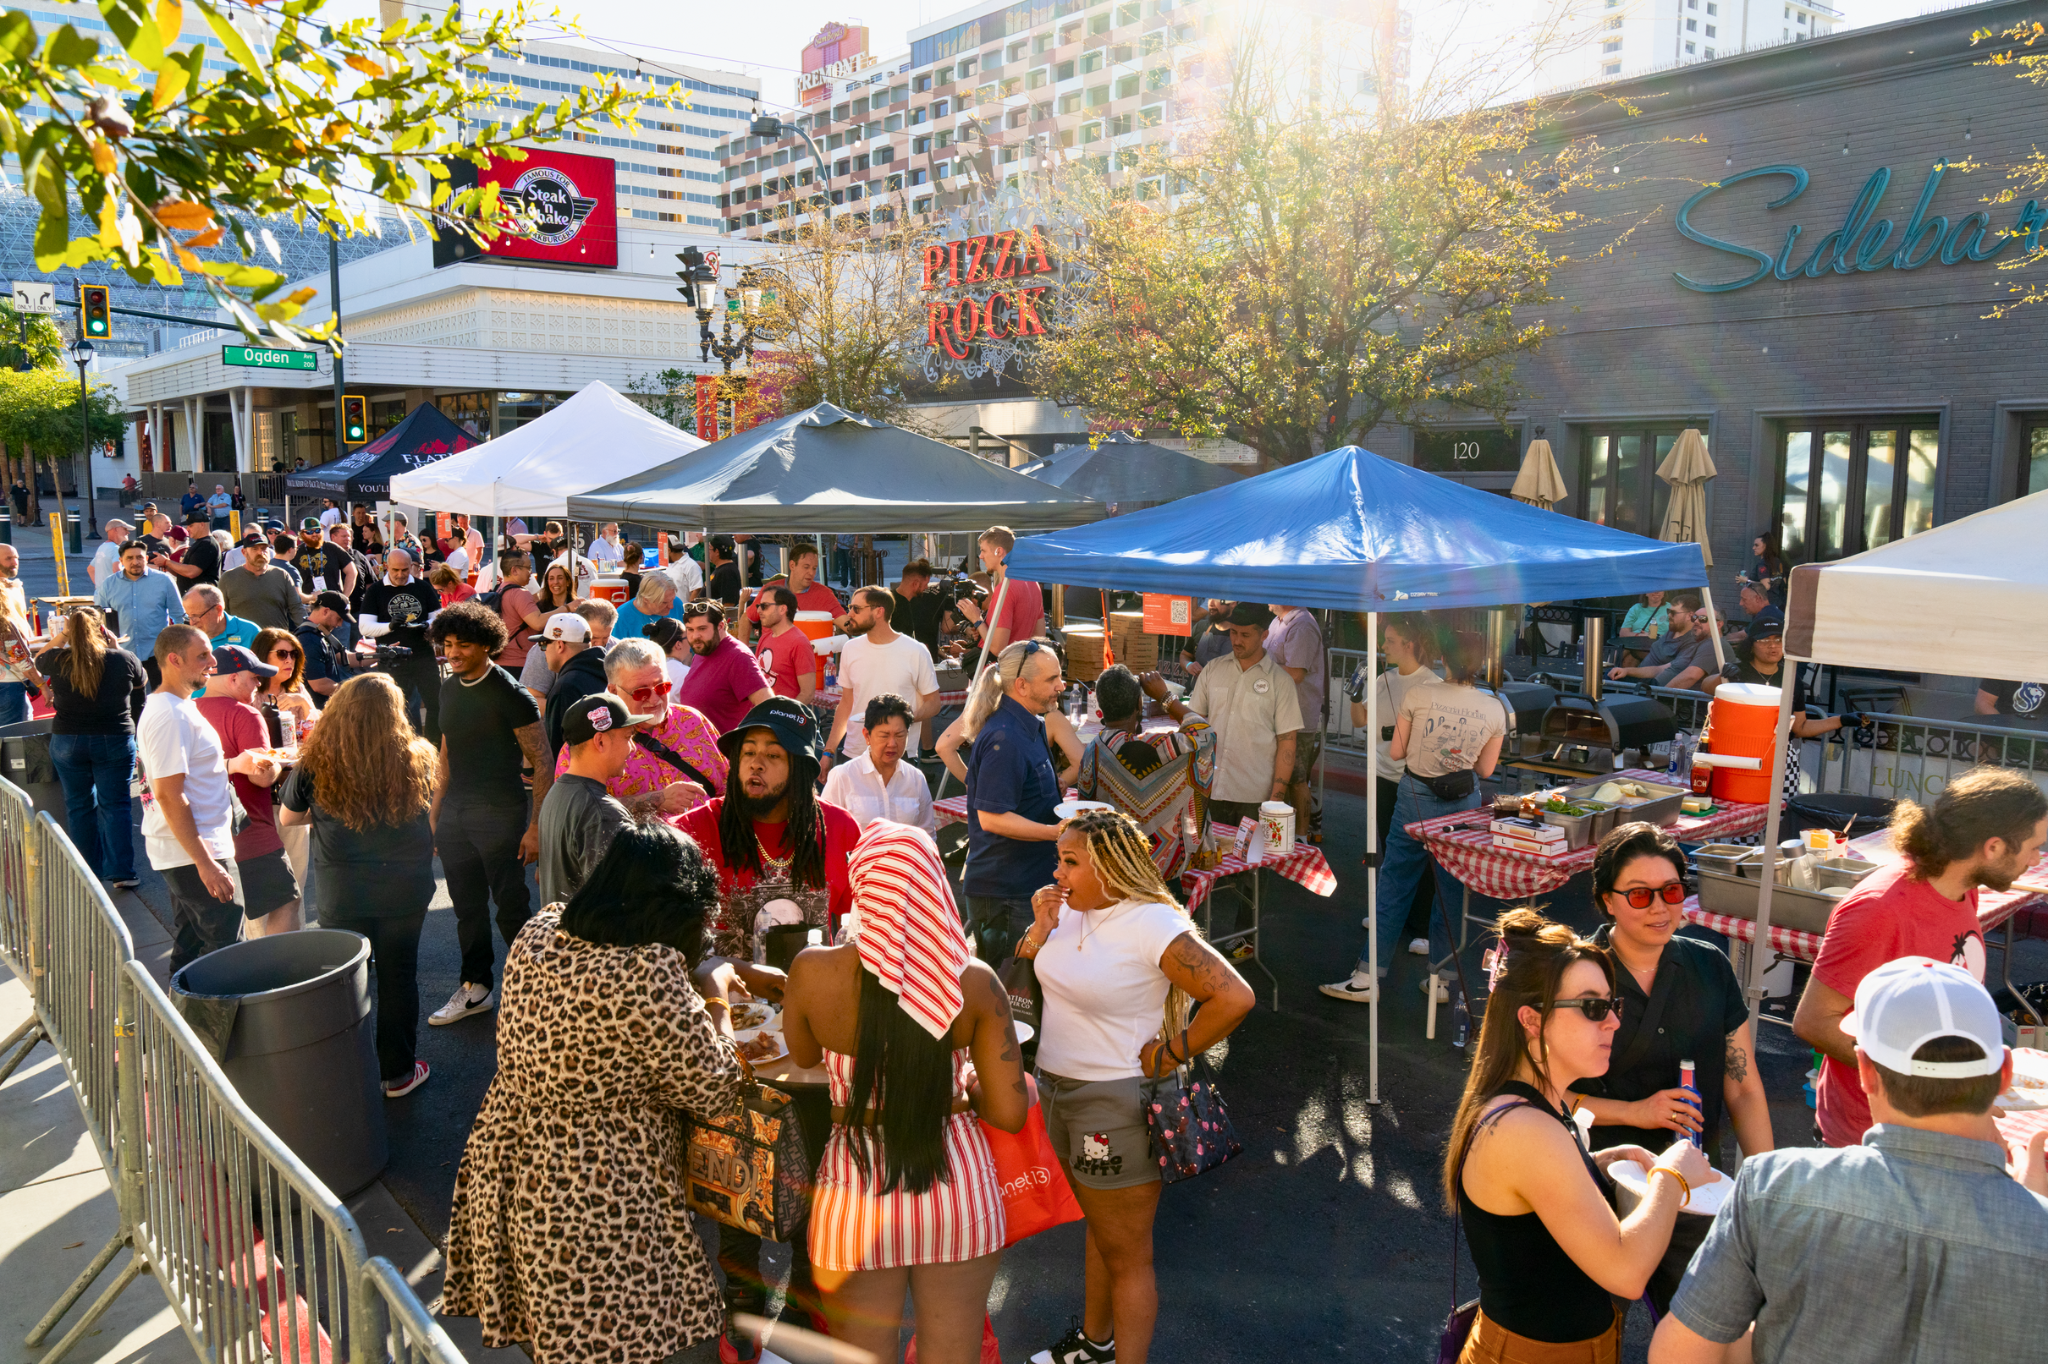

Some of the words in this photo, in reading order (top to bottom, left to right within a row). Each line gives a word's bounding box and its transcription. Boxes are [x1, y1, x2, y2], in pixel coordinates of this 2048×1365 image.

[794, 51, 867, 105] FREMONT
[523, 169, 555, 183] FAMOUS
[555, 172, 571, 188] FOR
[527, 184, 567, 204] Steak
[521, 222, 575, 244] STAKBURGERS
[1672, 156, 2048, 293] Sidebar
[921, 224, 1052, 291] PIZZA
[925, 286, 1048, 360] ROCK
[244, 348, 289, 366] Ogden
[703, 383, 712, 438] PIZZA
[1454, 441, 1480, 460] 120
[392, 595, 415, 604] METRO
[1431, 701, 1460, 714] Pizzeria
[1873, 766, 1944, 796] LUNC
[689, 1143, 759, 1200] ENDI
